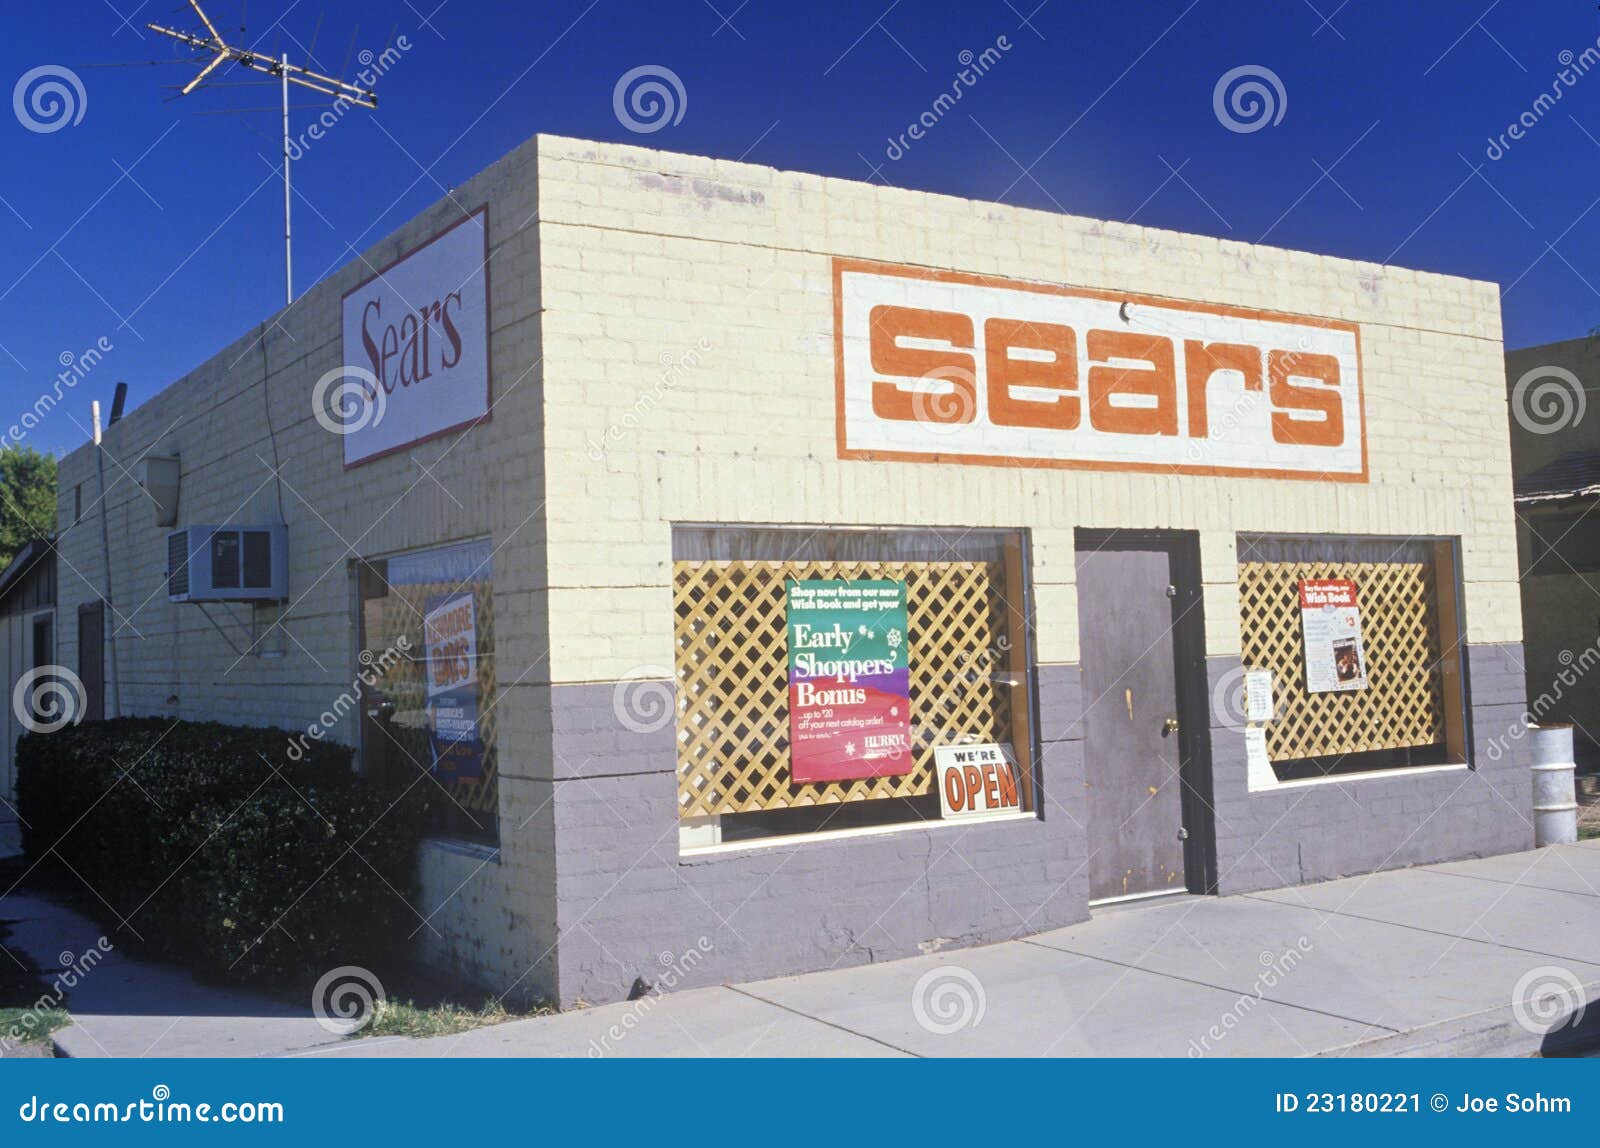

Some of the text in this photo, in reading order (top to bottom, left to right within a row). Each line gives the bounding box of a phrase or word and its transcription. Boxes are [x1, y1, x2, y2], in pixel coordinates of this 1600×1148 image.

[361, 289, 462, 400] Sears
[869, 303, 1344, 447] sears
[791, 586, 816, 600] Shop
[816, 588, 838, 596] now
[838, 586, 861, 596] from
[862, 588, 878, 596] our
[791, 598, 899, 611] Wish Book and get your
[1305, 592, 1350, 603] Wish Book
[793, 623, 853, 654] Early
[795, 650, 897, 683] Shoppers'
[796, 682, 866, 707] Bonus
[954, 750, 996, 762] WE'RE
[944, 763, 1018, 812] OPEN
